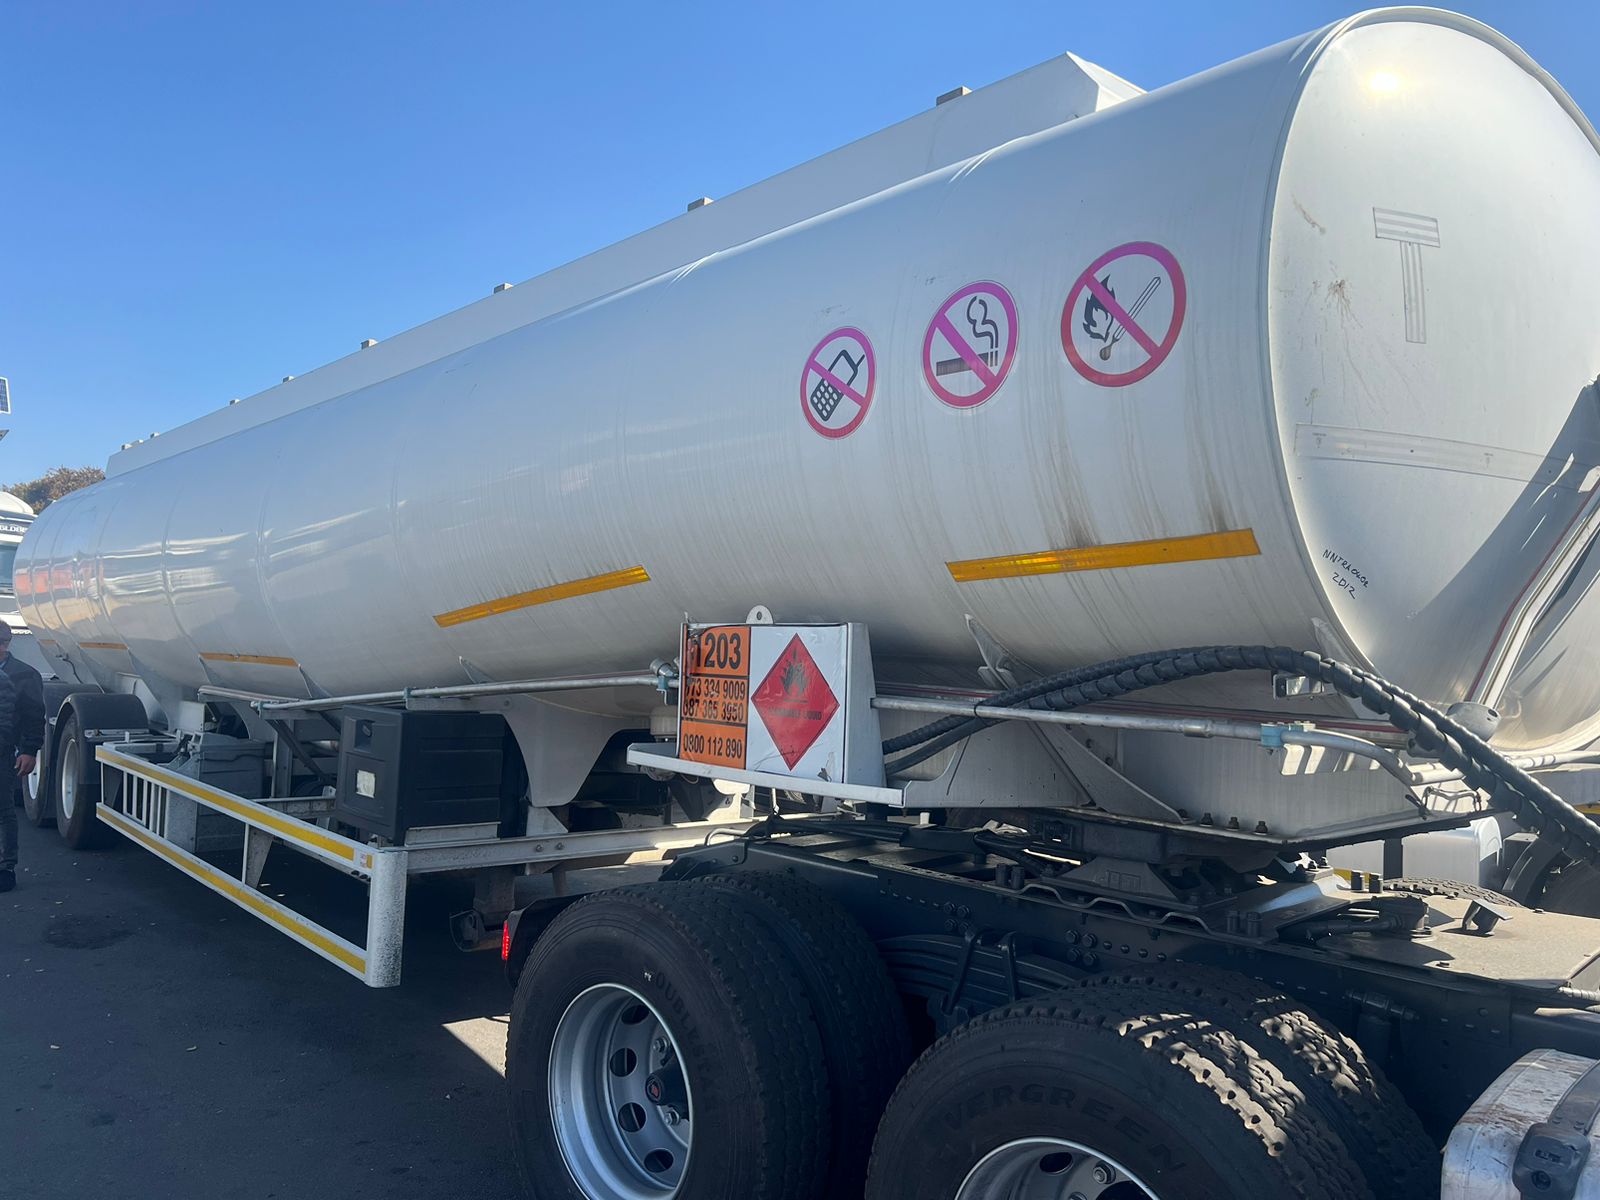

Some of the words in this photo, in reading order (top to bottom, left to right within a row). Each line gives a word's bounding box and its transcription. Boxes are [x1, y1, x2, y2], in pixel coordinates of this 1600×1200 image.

[693, 632, 742, 670] 1203
[723, 680, 745, 700] 9009
[707, 736, 723, 757] 112
[725, 738, 742, 759] 890
